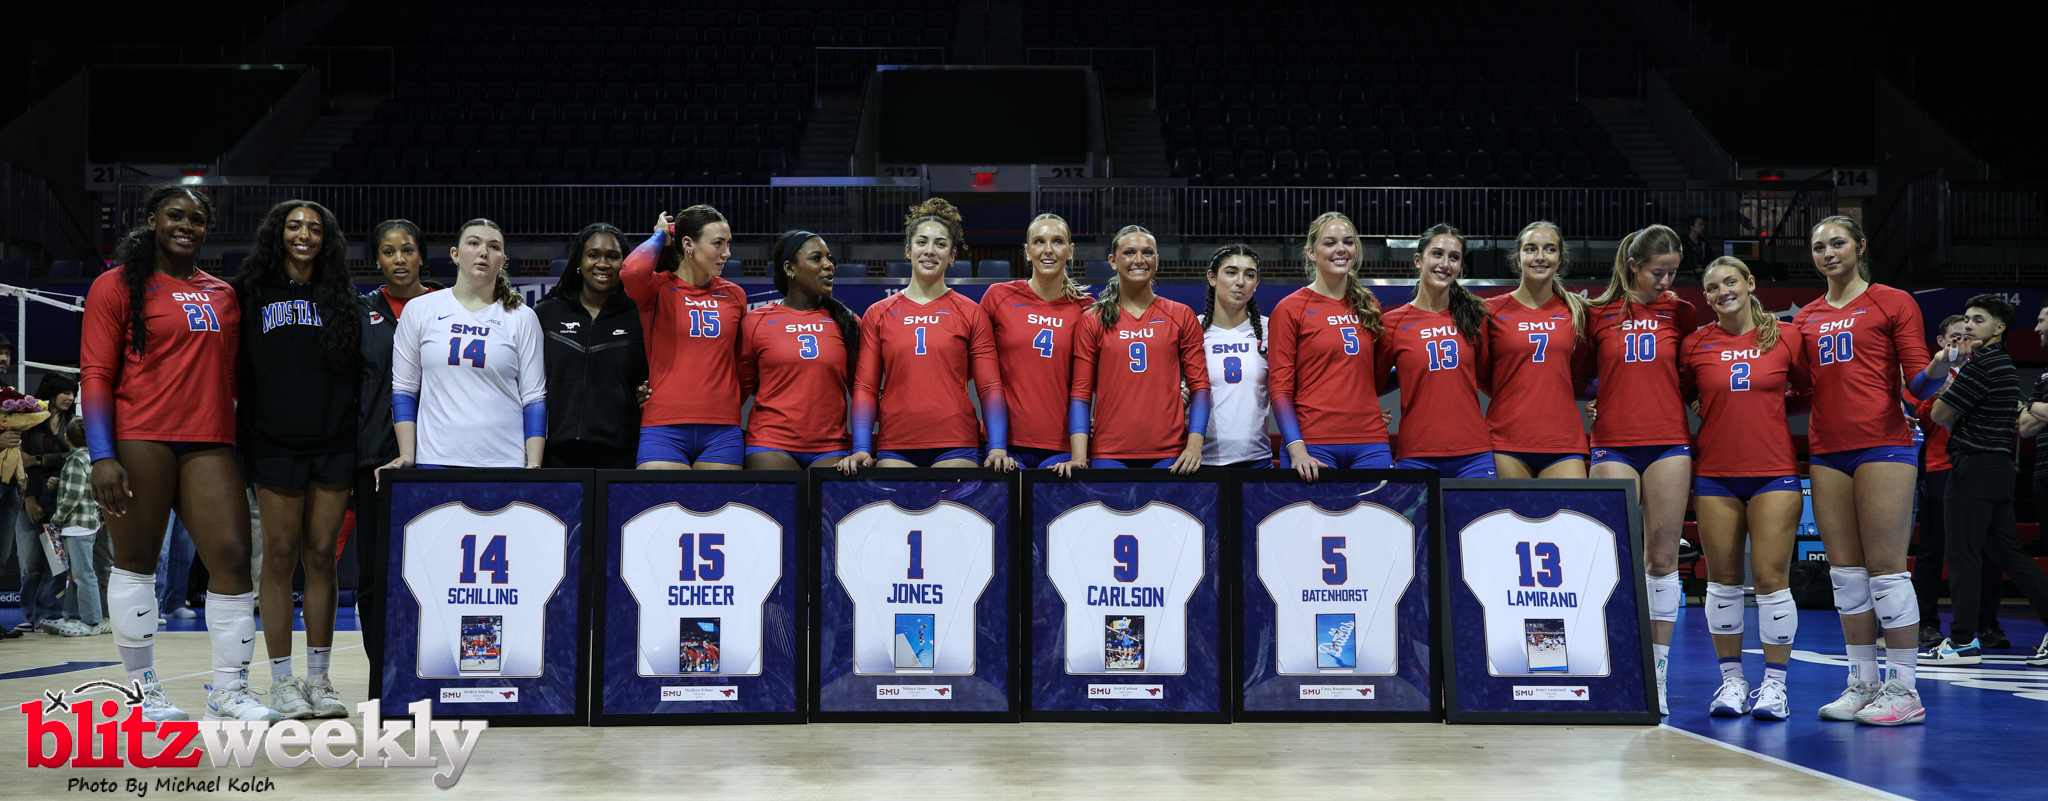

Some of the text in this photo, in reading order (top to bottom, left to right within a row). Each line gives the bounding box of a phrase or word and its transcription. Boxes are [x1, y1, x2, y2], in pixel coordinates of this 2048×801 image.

[93, 167, 114, 182] 21
[976, 173, 993, 185] EXIT
[1052, 167, 1084, 178] 213
[1837, 170, 1869, 186] 214
[172, 292, 210, 302] SMU
[684, 296, 719, 309] SMU
[1994, 292, 2021, 306] 14
[182, 303, 221, 332] 21
[689, 309, 721, 338] 15
[903, 315, 940, 325] SMU
[1027, 313, 1064, 328] SMU
[1326, 314, 1360, 326] SMU
[1518, 321, 1556, 331] SMU
[1621, 319, 1659, 331] SMU
[1819, 318, 1855, 333] SMU
[450, 323, 490, 337] SMU
[785, 323, 824, 333] SMU
[1119, 328, 1154, 339] SMU
[1420, 325, 1458, 339] SMU
[797, 334, 819, 360] 3
[914, 326, 927, 356] 1
[1032, 328, 1054, 358] 4
[1212, 343, 1250, 354] SMU
[1339, 327, 1360, 355] 5
[1528, 332, 1549, 363] 7
[1624, 332, 1657, 363] 10
[1817, 331, 1854, 366] 20
[448, 336, 487, 369] 14
[1128, 341, 1147, 373] 9
[1425, 339, 1459, 371] 13
[1720, 348, 1761, 361] SMU
[1223, 356, 1242, 384] 8
[1730, 362, 1750, 392] 2
[459, 534, 509, 584] 14
[679, 533, 725, 581] 15
[907, 530, 924, 579] 1
[1113, 534, 1139, 583] 9
[1321, 536, 1348, 585] 5
[1515, 541, 1563, 588] 13
[447, 587, 518, 605] SCHILLING
[668, 585, 734, 606] SCHEER
[886, 583, 943, 605] JONES
[1087, 585, 1164, 608] CARLSON
[1302, 589, 1368, 602] BATENHORST
[1507, 589, 1578, 608] LAMIRAND
[442, 691, 461, 699] SMU
[1090, 687, 1111, 695] SMU
